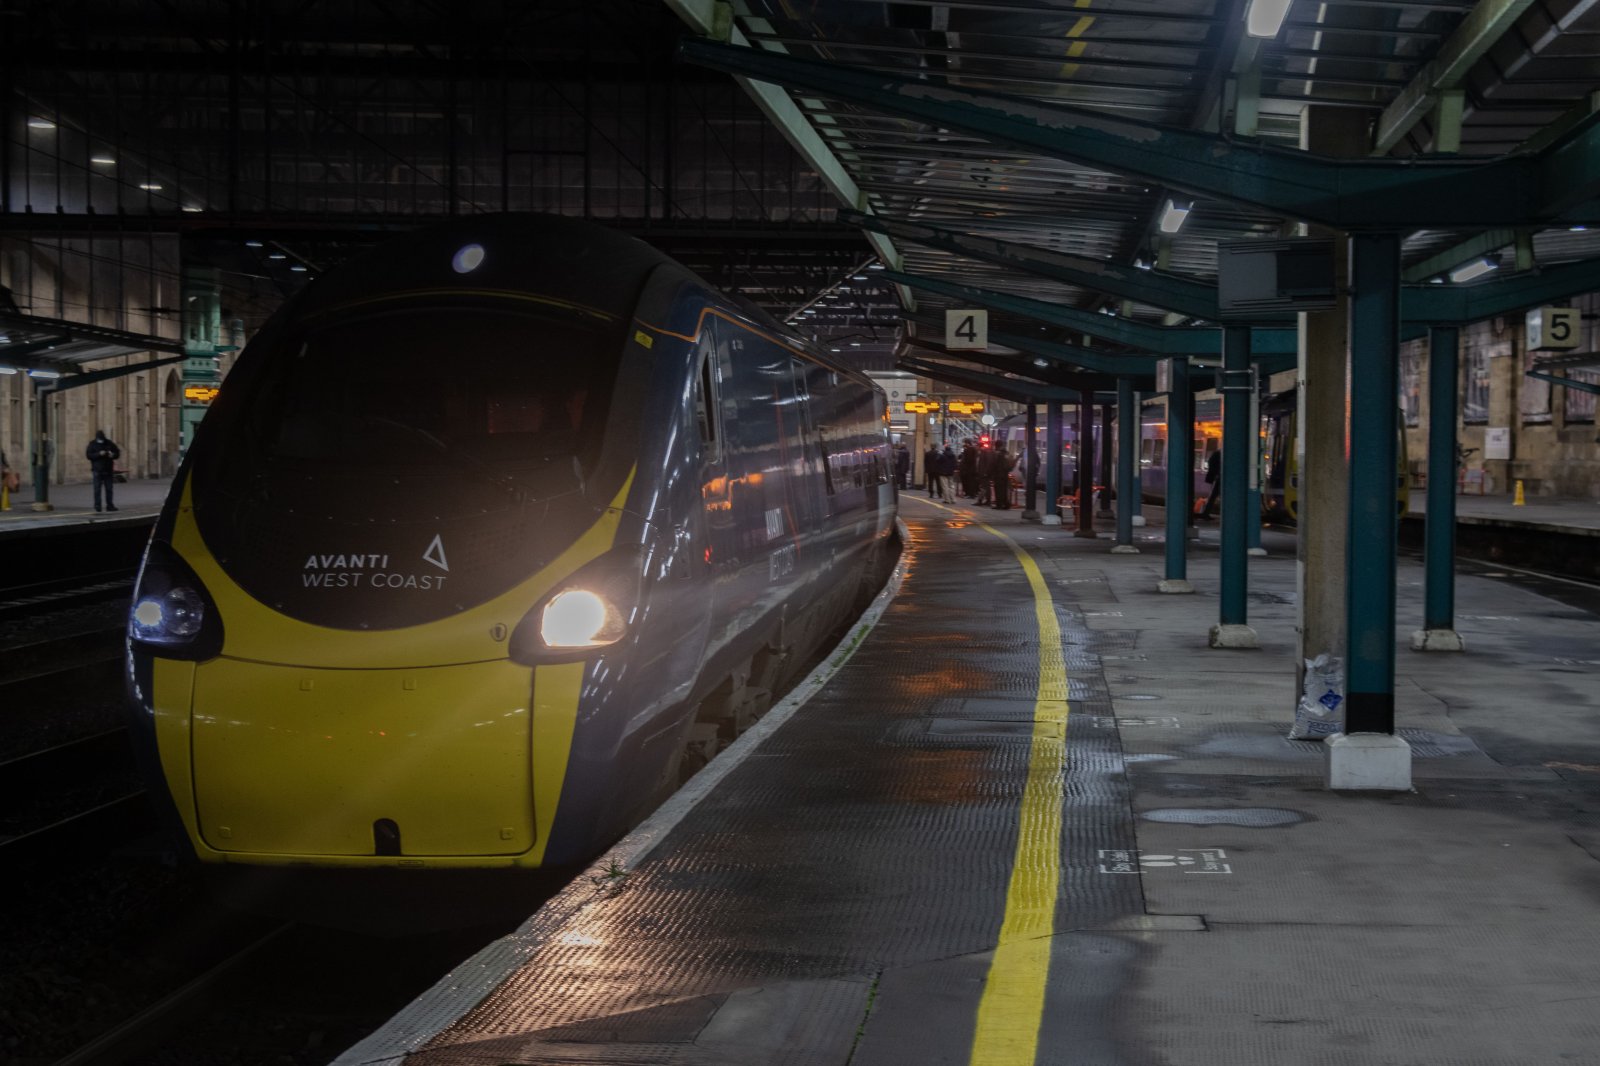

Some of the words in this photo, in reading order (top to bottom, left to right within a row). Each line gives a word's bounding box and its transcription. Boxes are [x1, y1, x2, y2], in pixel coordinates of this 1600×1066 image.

[955, 315, 977, 342] 4
[1551, 314, 1570, 341] 5
[304, 554, 389, 569] AVANTI
[302, 572, 364, 588] WEST
[370, 573, 447, 590] COAST
